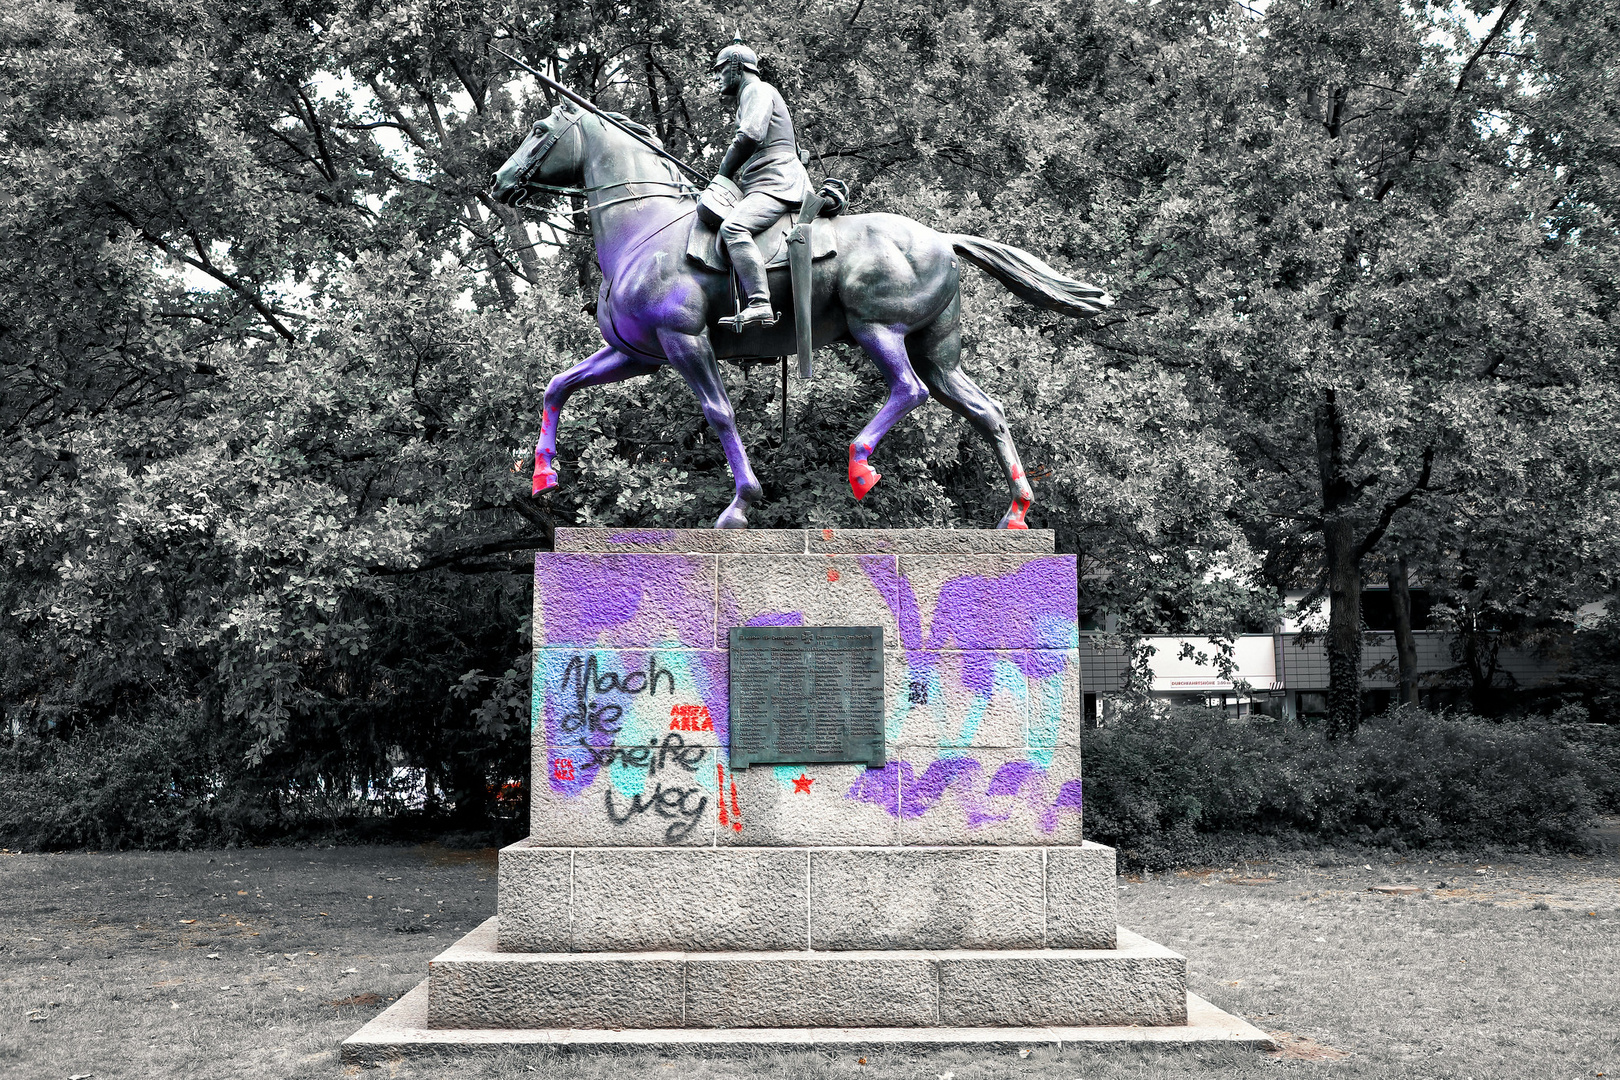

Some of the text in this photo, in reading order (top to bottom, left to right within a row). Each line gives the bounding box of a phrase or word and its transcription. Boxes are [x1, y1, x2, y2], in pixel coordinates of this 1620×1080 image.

[560, 655, 675, 696] Mach
[561, 698, 623, 733] die
[669, 716, 714, 731] AREA
[554, 758, 574, 768] FCK
